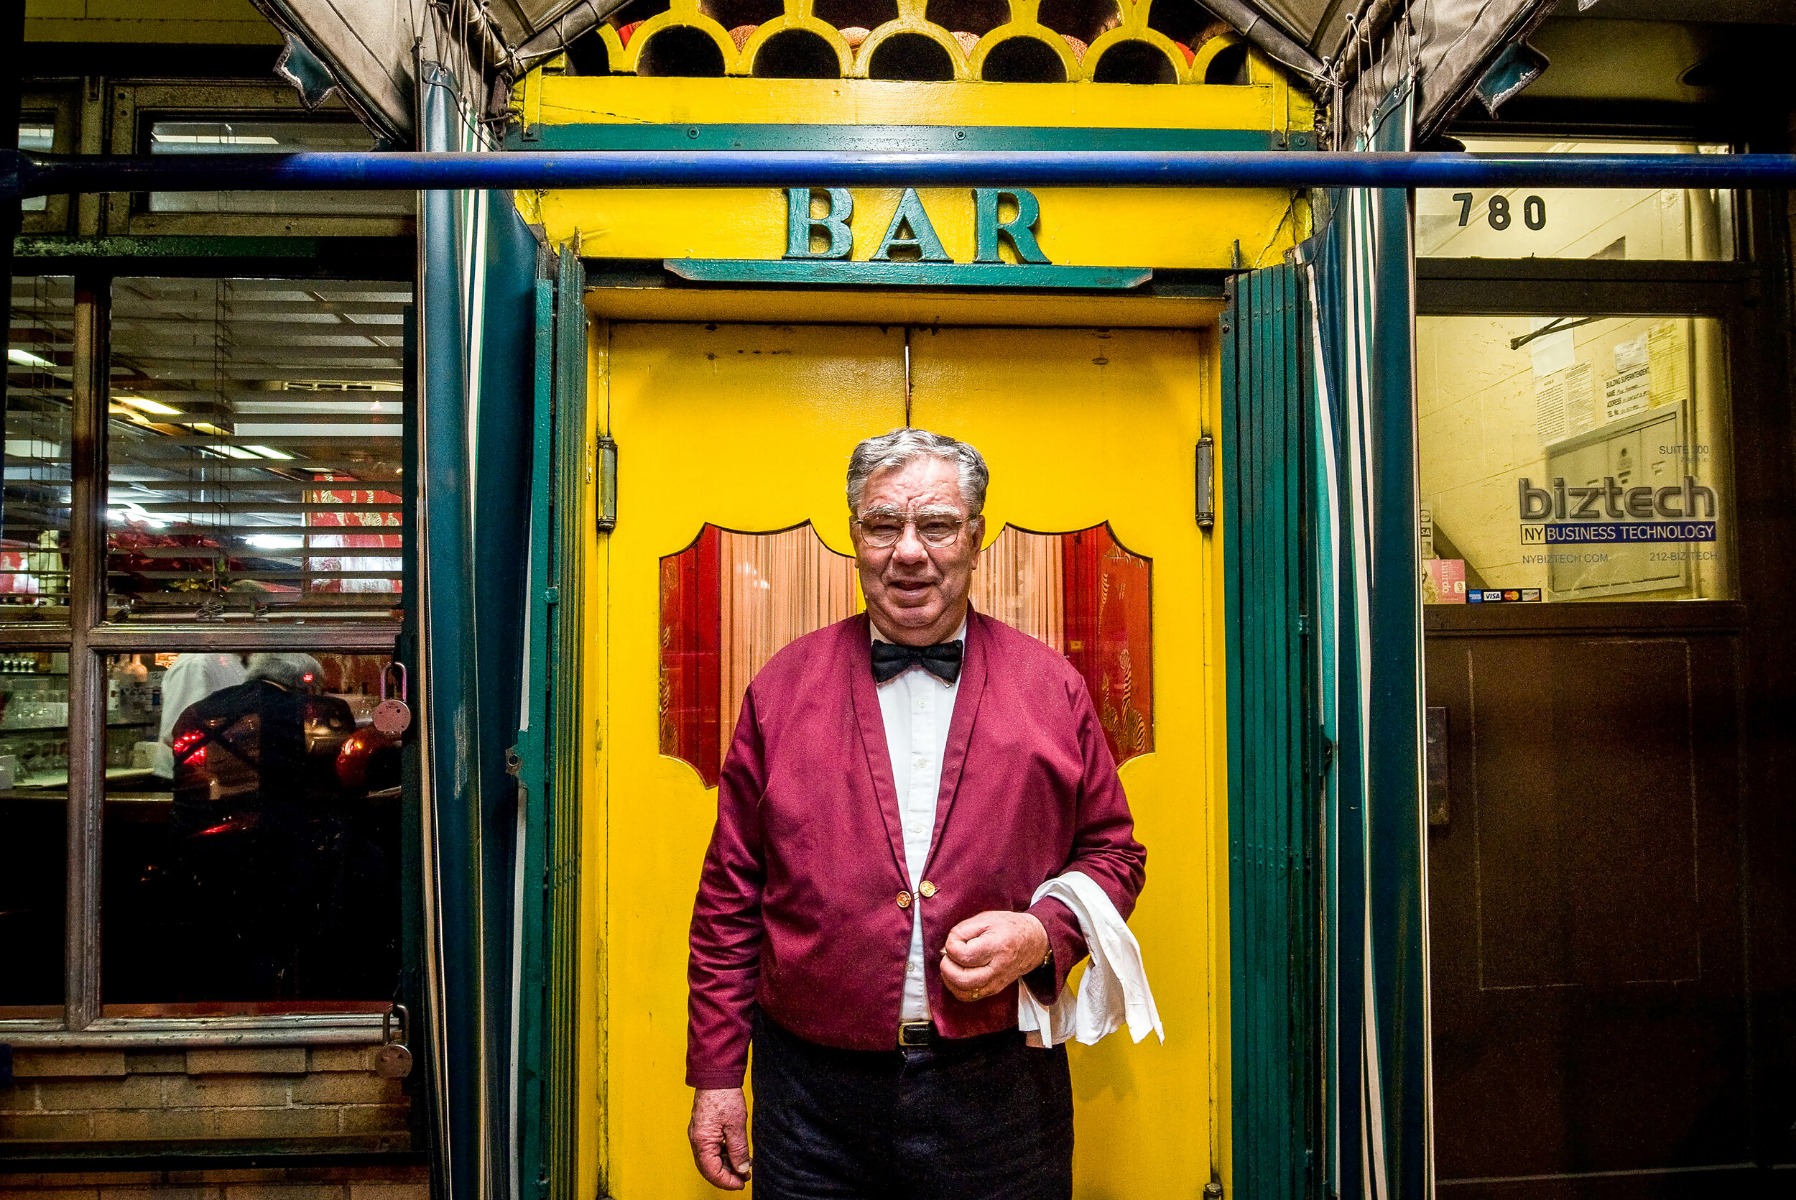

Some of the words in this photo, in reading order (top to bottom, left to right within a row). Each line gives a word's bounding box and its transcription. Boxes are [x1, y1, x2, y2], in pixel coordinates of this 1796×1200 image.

[1452, 192, 1546, 231] 780
[782, 188, 1052, 264] BAR
[1659, 445, 1689, 455] SUITE
[1519, 476, 1715, 519] biztech
[1524, 527, 1544, 541] NY
[1547, 526, 1616, 541] BUSINESS
[1620, 525, 1715, 540] TECHNOLOGY
[1522, 553, 1609, 564] NYBIZTECH.COM
[1485, 592, 1501, 600] VISA
